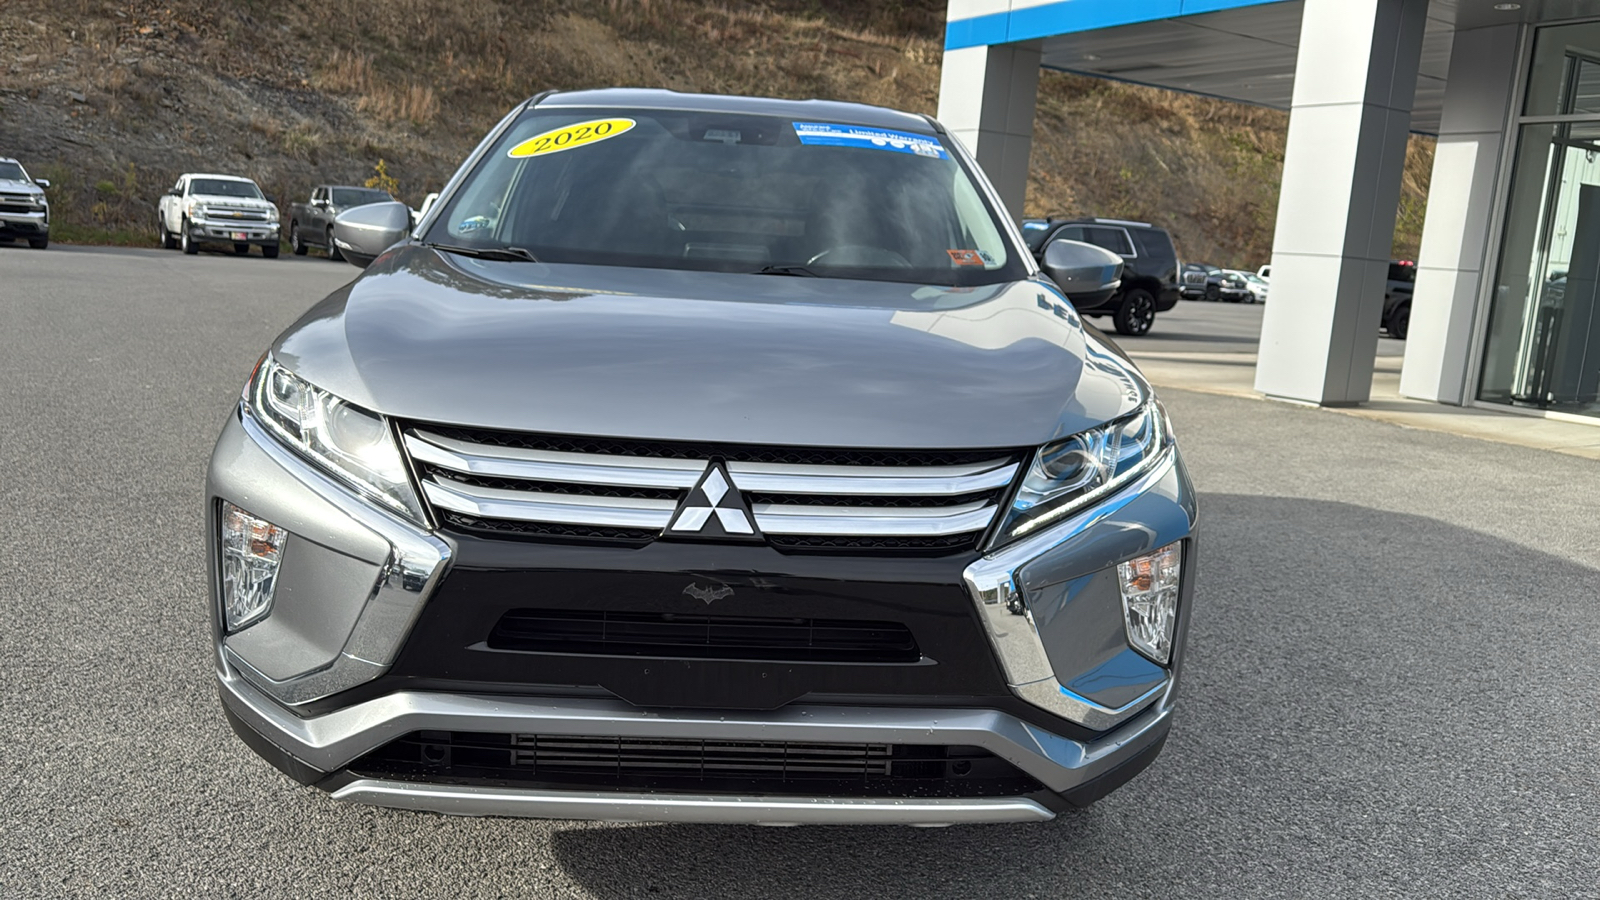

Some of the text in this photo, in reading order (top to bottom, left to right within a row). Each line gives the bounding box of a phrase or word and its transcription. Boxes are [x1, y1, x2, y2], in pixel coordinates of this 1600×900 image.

[534, 122, 612, 153] 2020
[848, 128, 887, 139] Limited
[887, 132, 934, 145] Warranty
